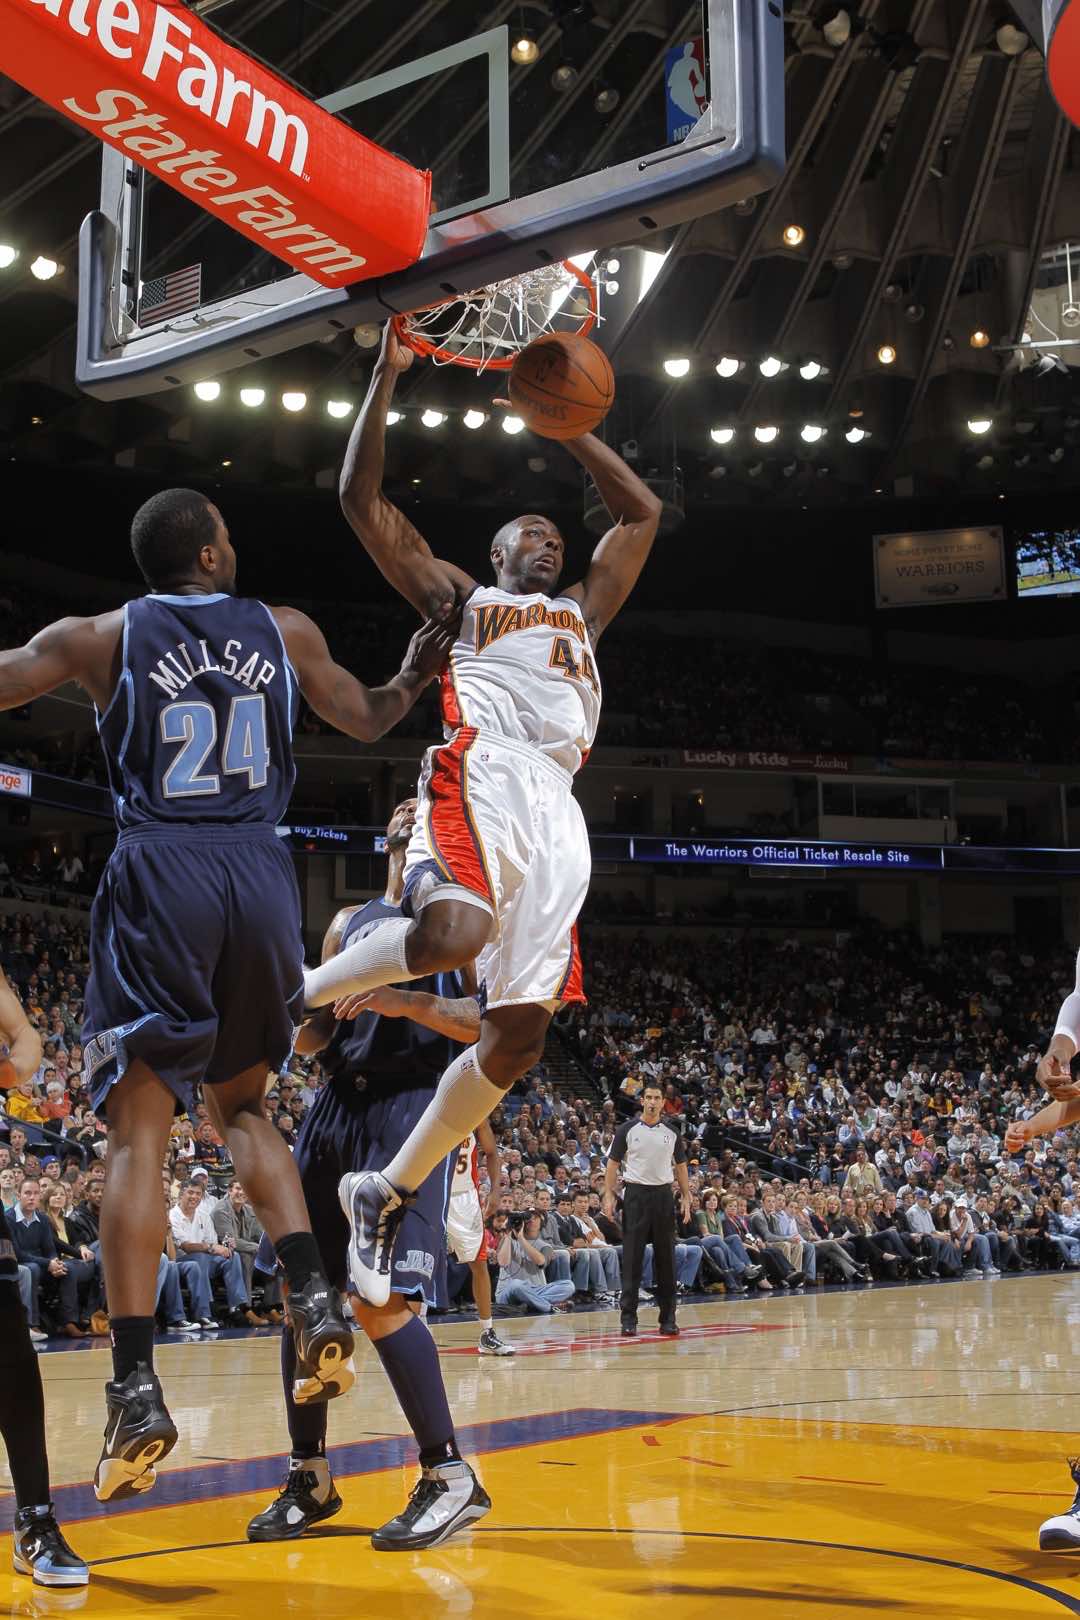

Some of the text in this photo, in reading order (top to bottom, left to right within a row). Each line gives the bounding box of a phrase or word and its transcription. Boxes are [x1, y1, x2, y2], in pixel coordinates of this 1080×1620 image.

[142, 4, 309, 177] Farm
[673, 122, 697, 142] NB
[62, 89, 367, 274] State Farm
[896, 560, 985, 577] WARRIORS
[148, 639, 276, 700] MILLSAP
[160, 693, 270, 799] 24
[684, 751, 736, 766] Lucky
[749, 752, 789, 766] Kids
[666, 844, 910, 862] The Warriors Official Ticket Resale Site
[313, 1291, 328, 1300] NIKE
[138, 1383, 153, 1392] NIKE
